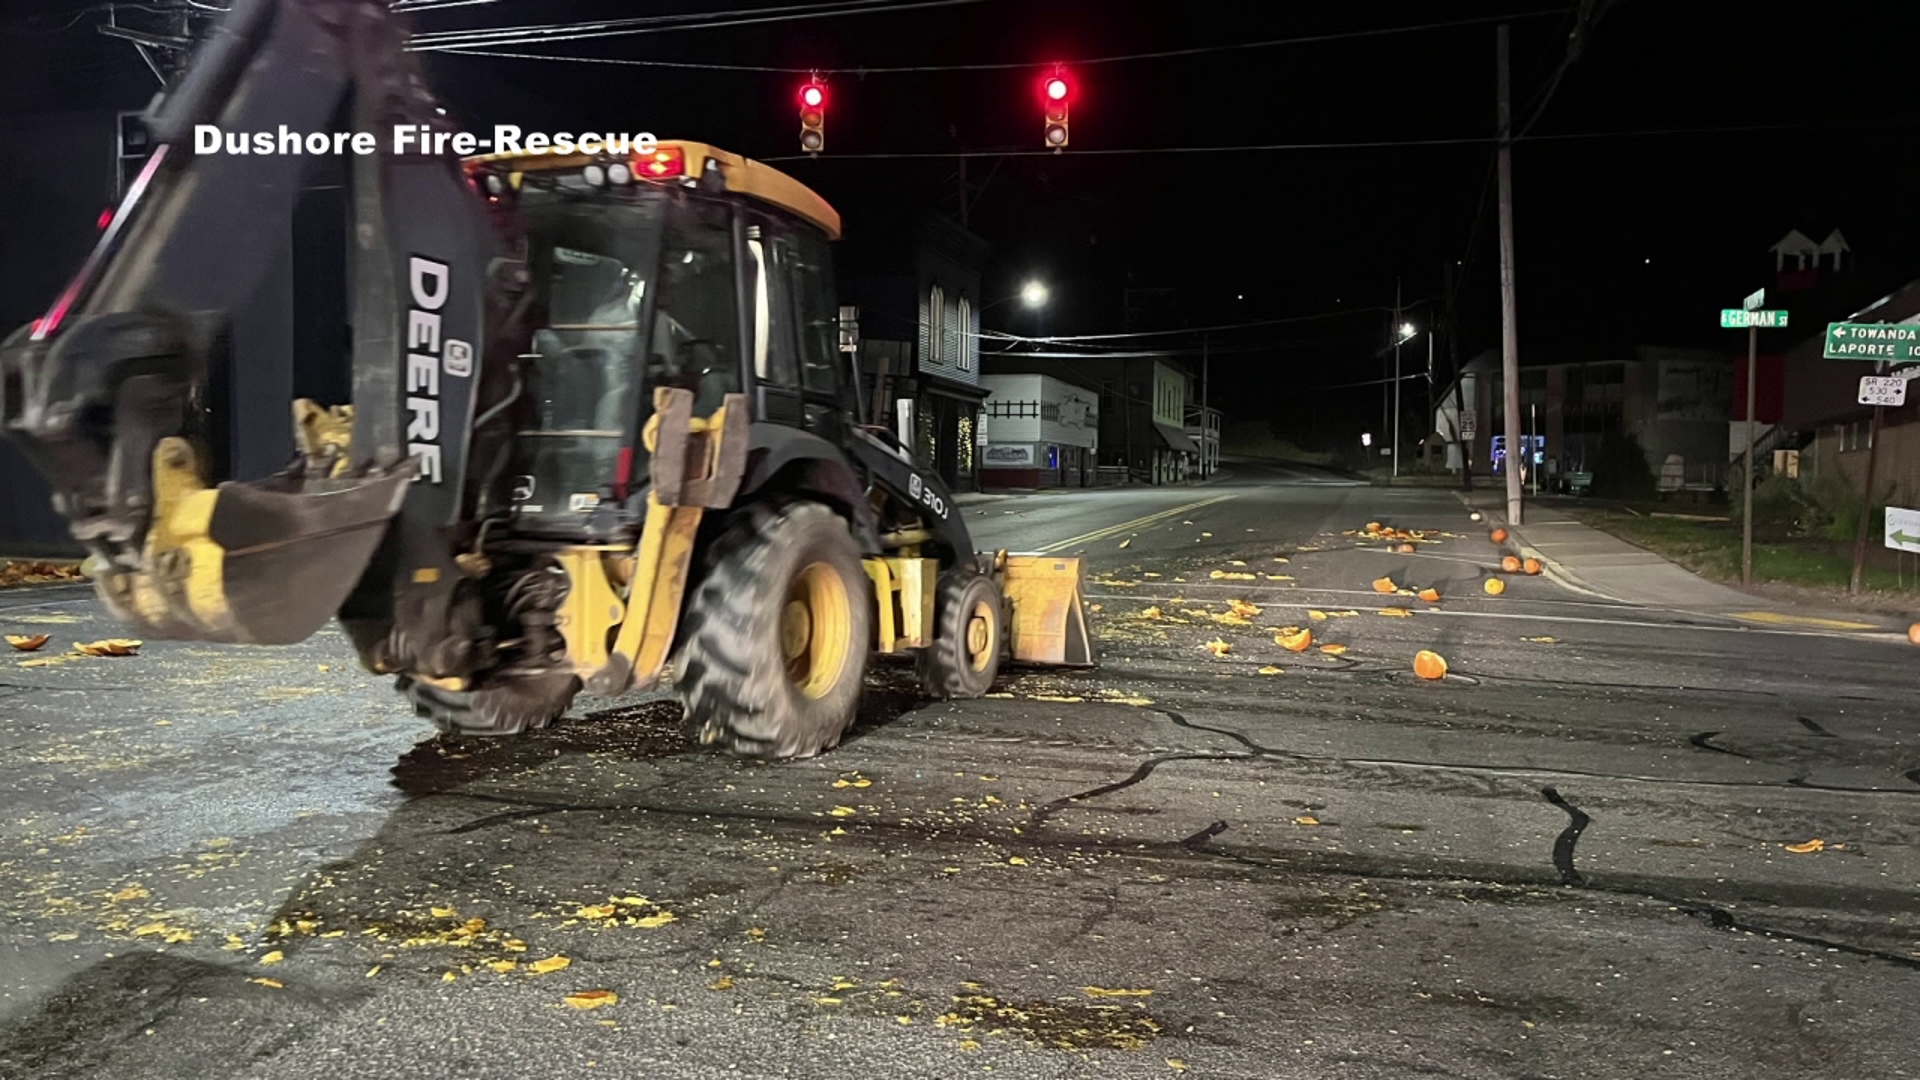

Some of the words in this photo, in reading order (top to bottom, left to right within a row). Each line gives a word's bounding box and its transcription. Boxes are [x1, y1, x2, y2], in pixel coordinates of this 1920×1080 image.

[1729, 311, 1776, 327] GERMAN
[1778, 316, 1788, 326] ST
[1850, 328, 1917, 340] TOWANDA
[1829, 343, 1895, 356] LAPORTE
[407, 256, 449, 484] DEERE
[1865, 378, 1877, 386] SR
[1883, 378, 1903, 387] 220
[1869, 387, 1888, 395] 530
[1876, 395, 1896, 404] 540
[923, 487, 949, 520] 310J
